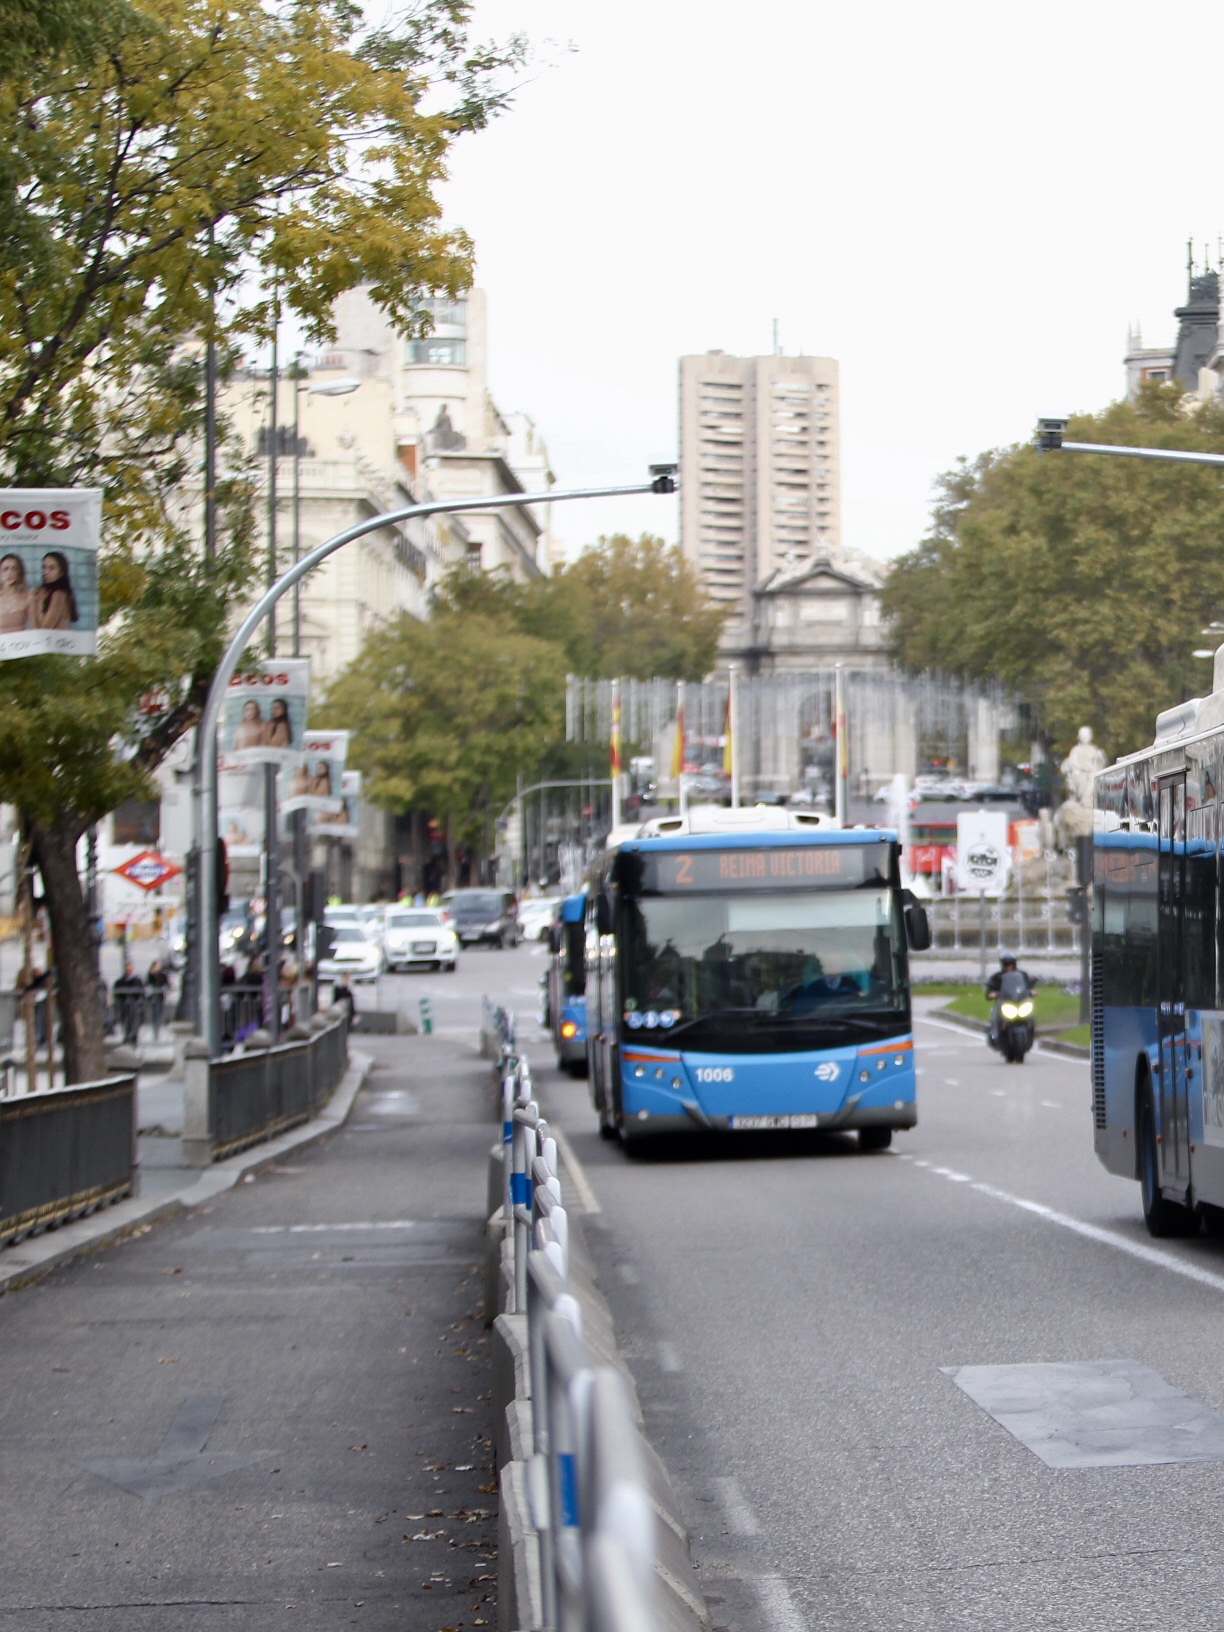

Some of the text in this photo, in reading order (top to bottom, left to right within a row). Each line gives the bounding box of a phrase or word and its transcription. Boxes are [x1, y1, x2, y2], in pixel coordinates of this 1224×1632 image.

[675, 850, 841, 885] 2 REINA VICTORIA
[695, 1068, 733, 1082] 1006
